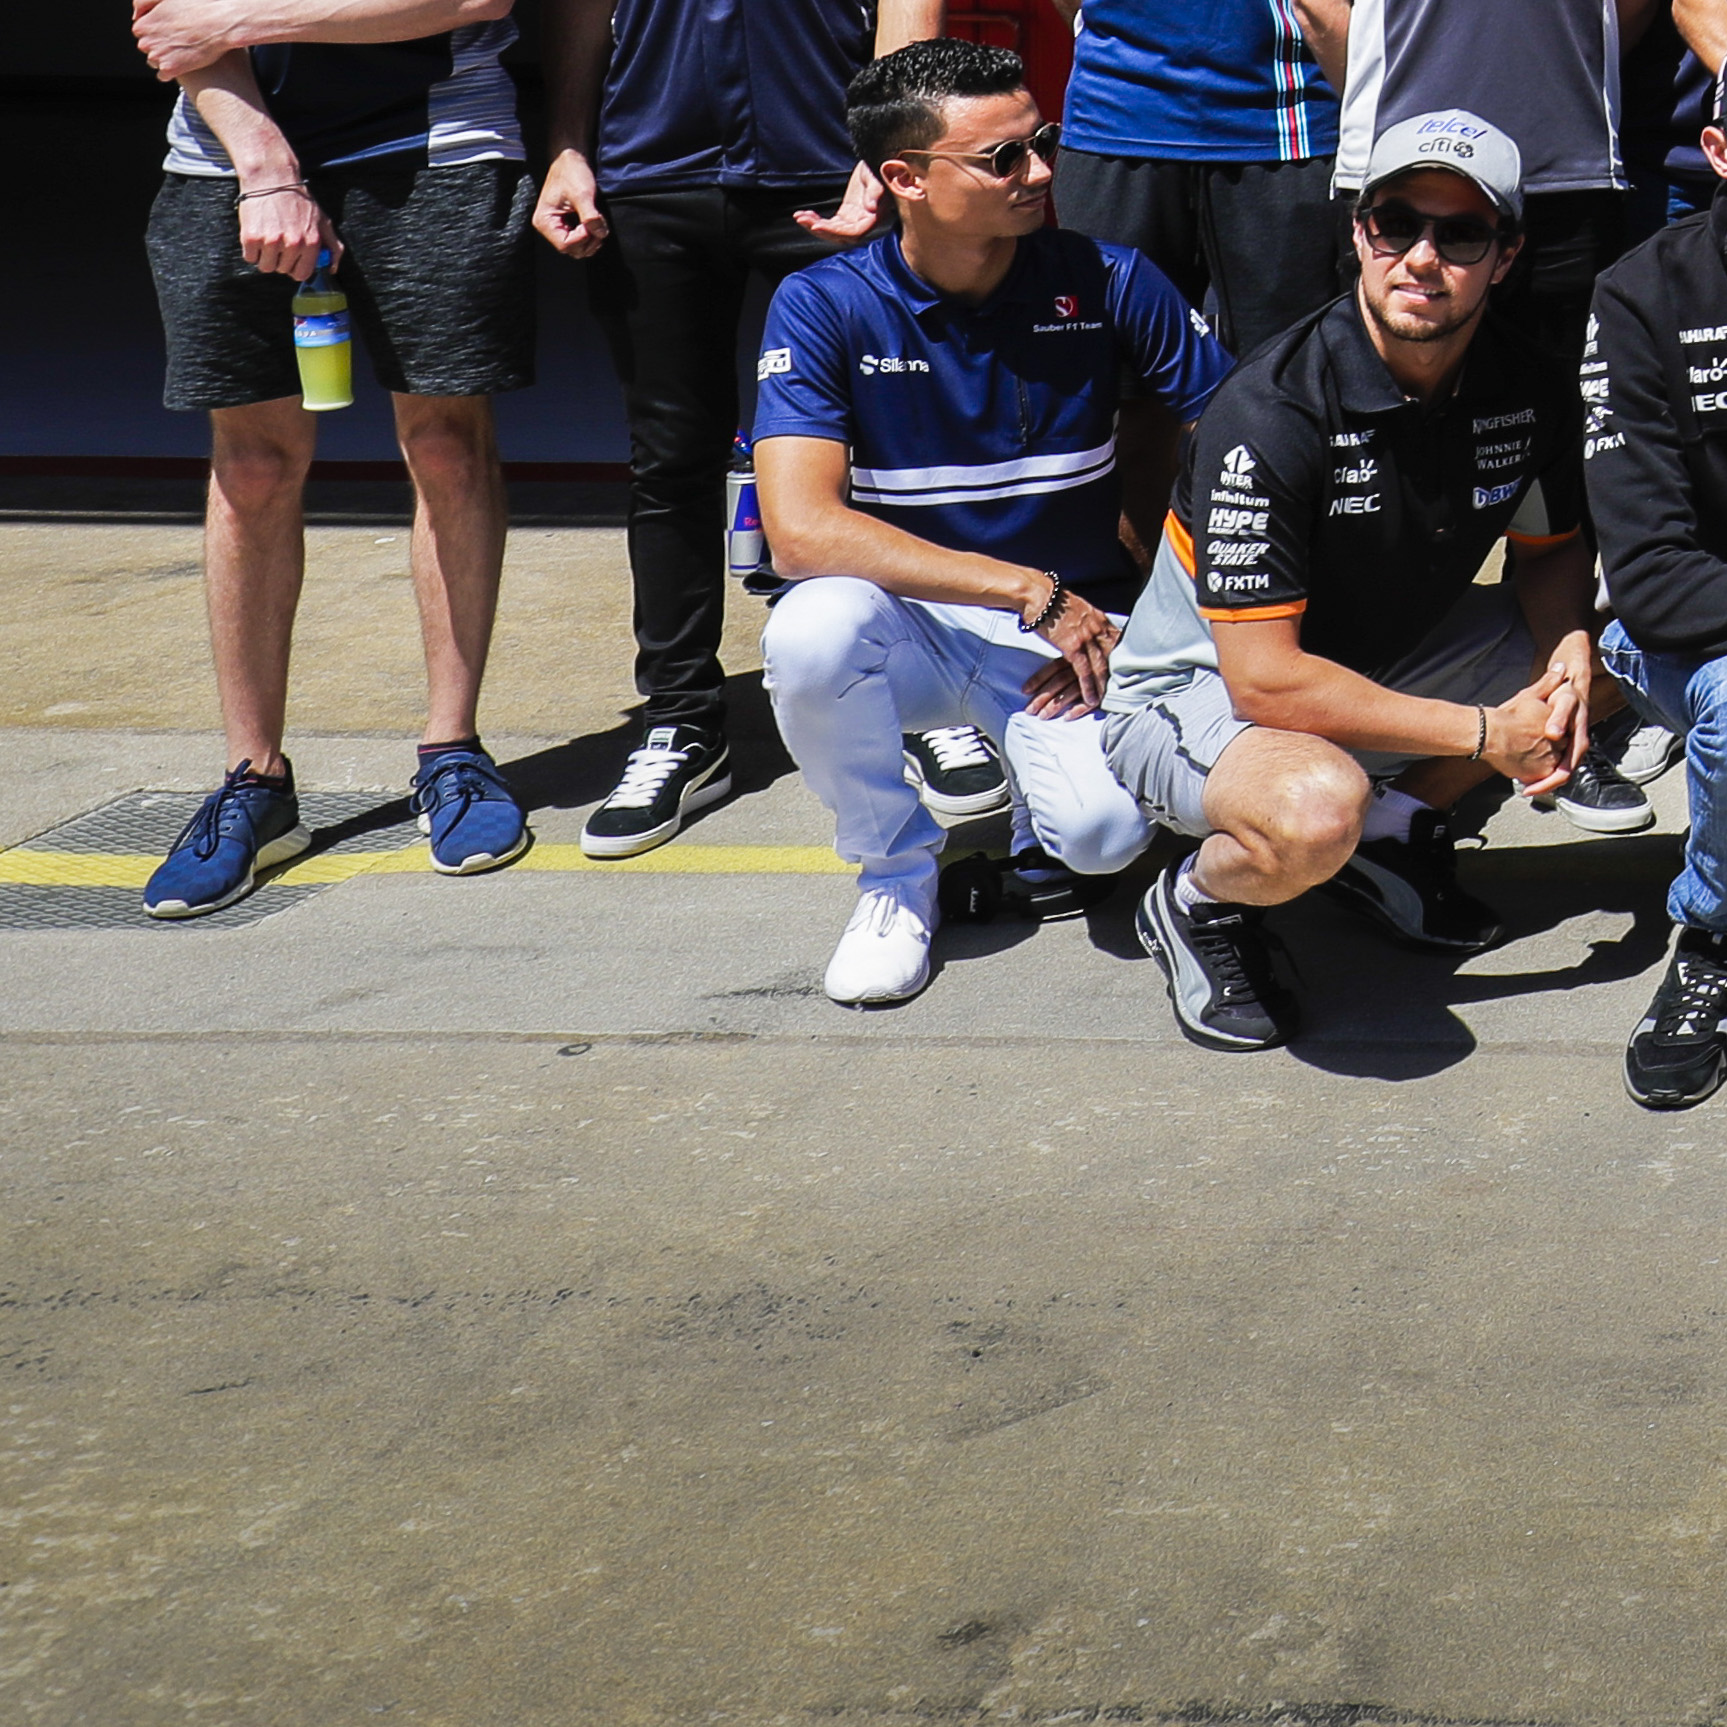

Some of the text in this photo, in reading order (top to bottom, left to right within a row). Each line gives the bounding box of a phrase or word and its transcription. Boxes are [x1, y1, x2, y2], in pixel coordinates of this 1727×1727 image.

[1416, 118, 1488, 139] telcel
[1418, 137, 1451, 153] citi
[1033, 322, 1103, 333] Sauber F1 Team
[880, 357, 930, 373] Silanna
[1473, 409, 1536, 434] KINGFISHER
[1475, 440, 1522, 460] JOHNNIE
[1477, 454, 1521, 470] WALKER
[1220, 470, 1252, 489] INTER
[1334, 460, 1377, 484] Clao
[1211, 489, 1270, 507] infinitum
[1329, 494, 1381, 516] NEC
[1208, 508, 1270, 531] HYPE
[1207, 540, 1270, 555] QUAKER
[1211, 553, 1259, 566] STATE
[1225, 574, 1269, 590] FXTM
